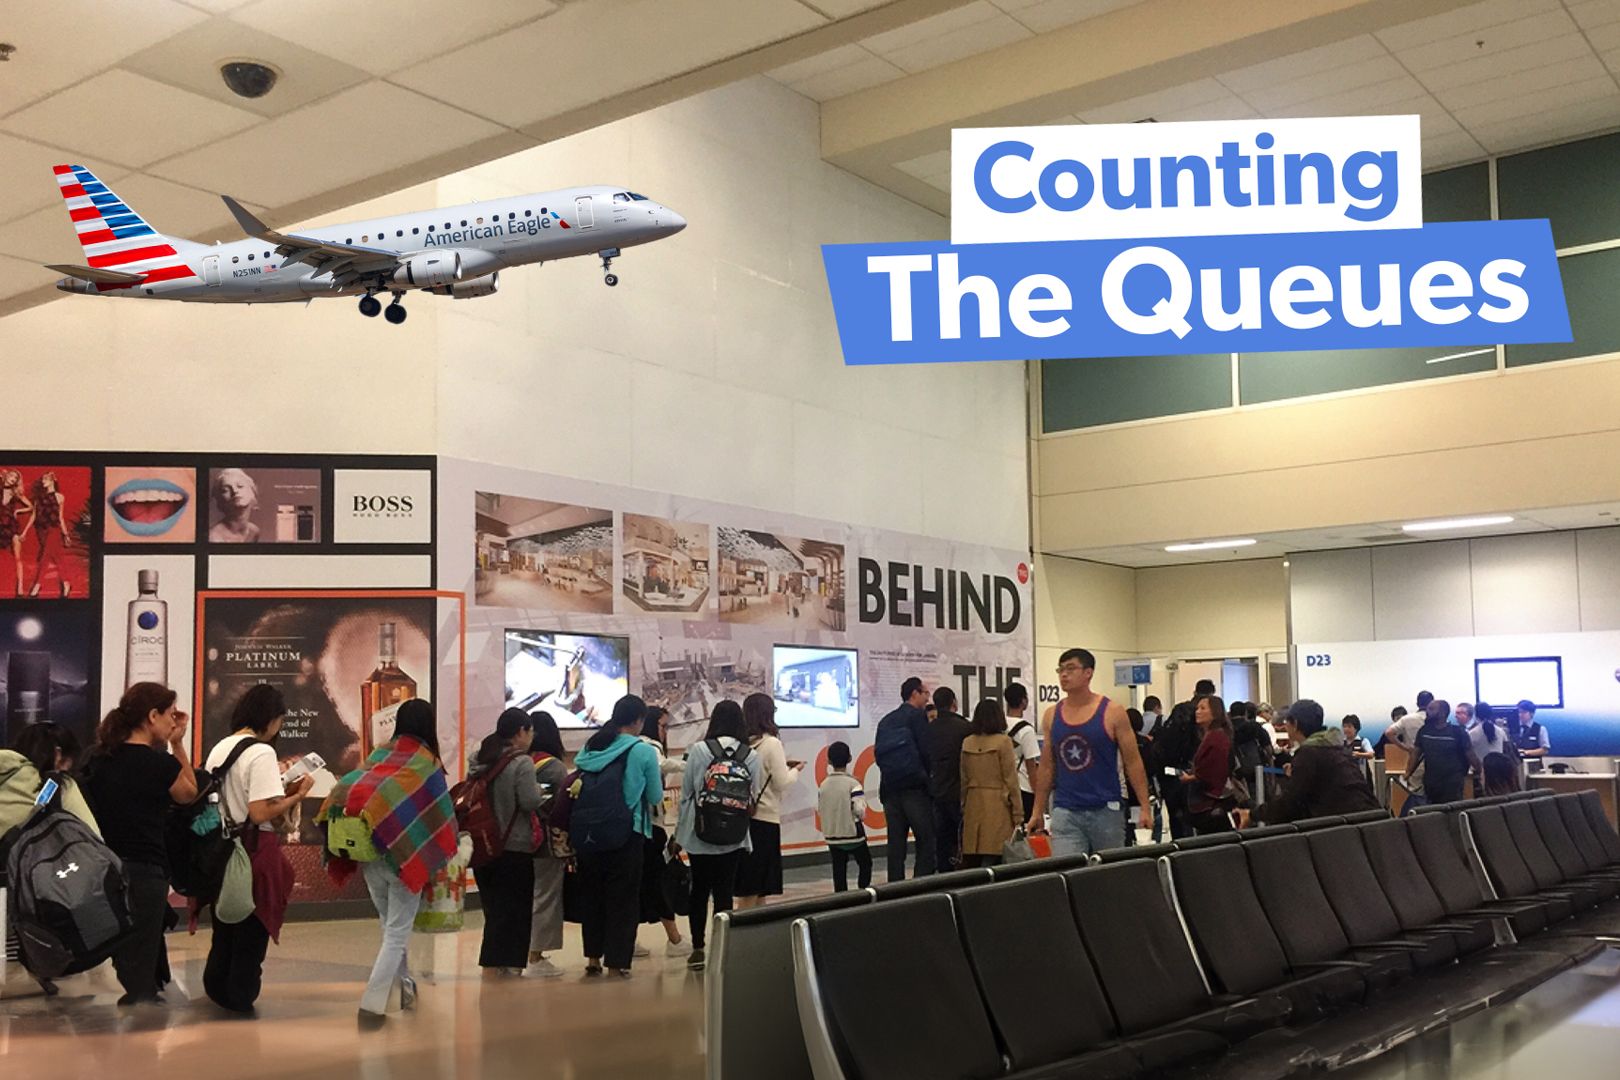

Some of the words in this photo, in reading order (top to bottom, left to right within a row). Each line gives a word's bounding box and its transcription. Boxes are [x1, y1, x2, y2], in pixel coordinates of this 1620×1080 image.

[424, 224, 503, 248] American
[507, 215, 551, 236] Eagle
[232, 266, 262, 278] N251NN
[352, 495, 414, 512] BOSS
[858, 557, 1021, 634] BEHIND
[226, 652, 301, 661] PLATINUM
[1306, 654, 1331, 667] D23
[1039, 685, 1060, 702] D23
[285, 709, 298, 717] he
[300, 709, 319, 717] New
[301, 719, 311, 727] of
[280, 730, 309, 738] Walker
